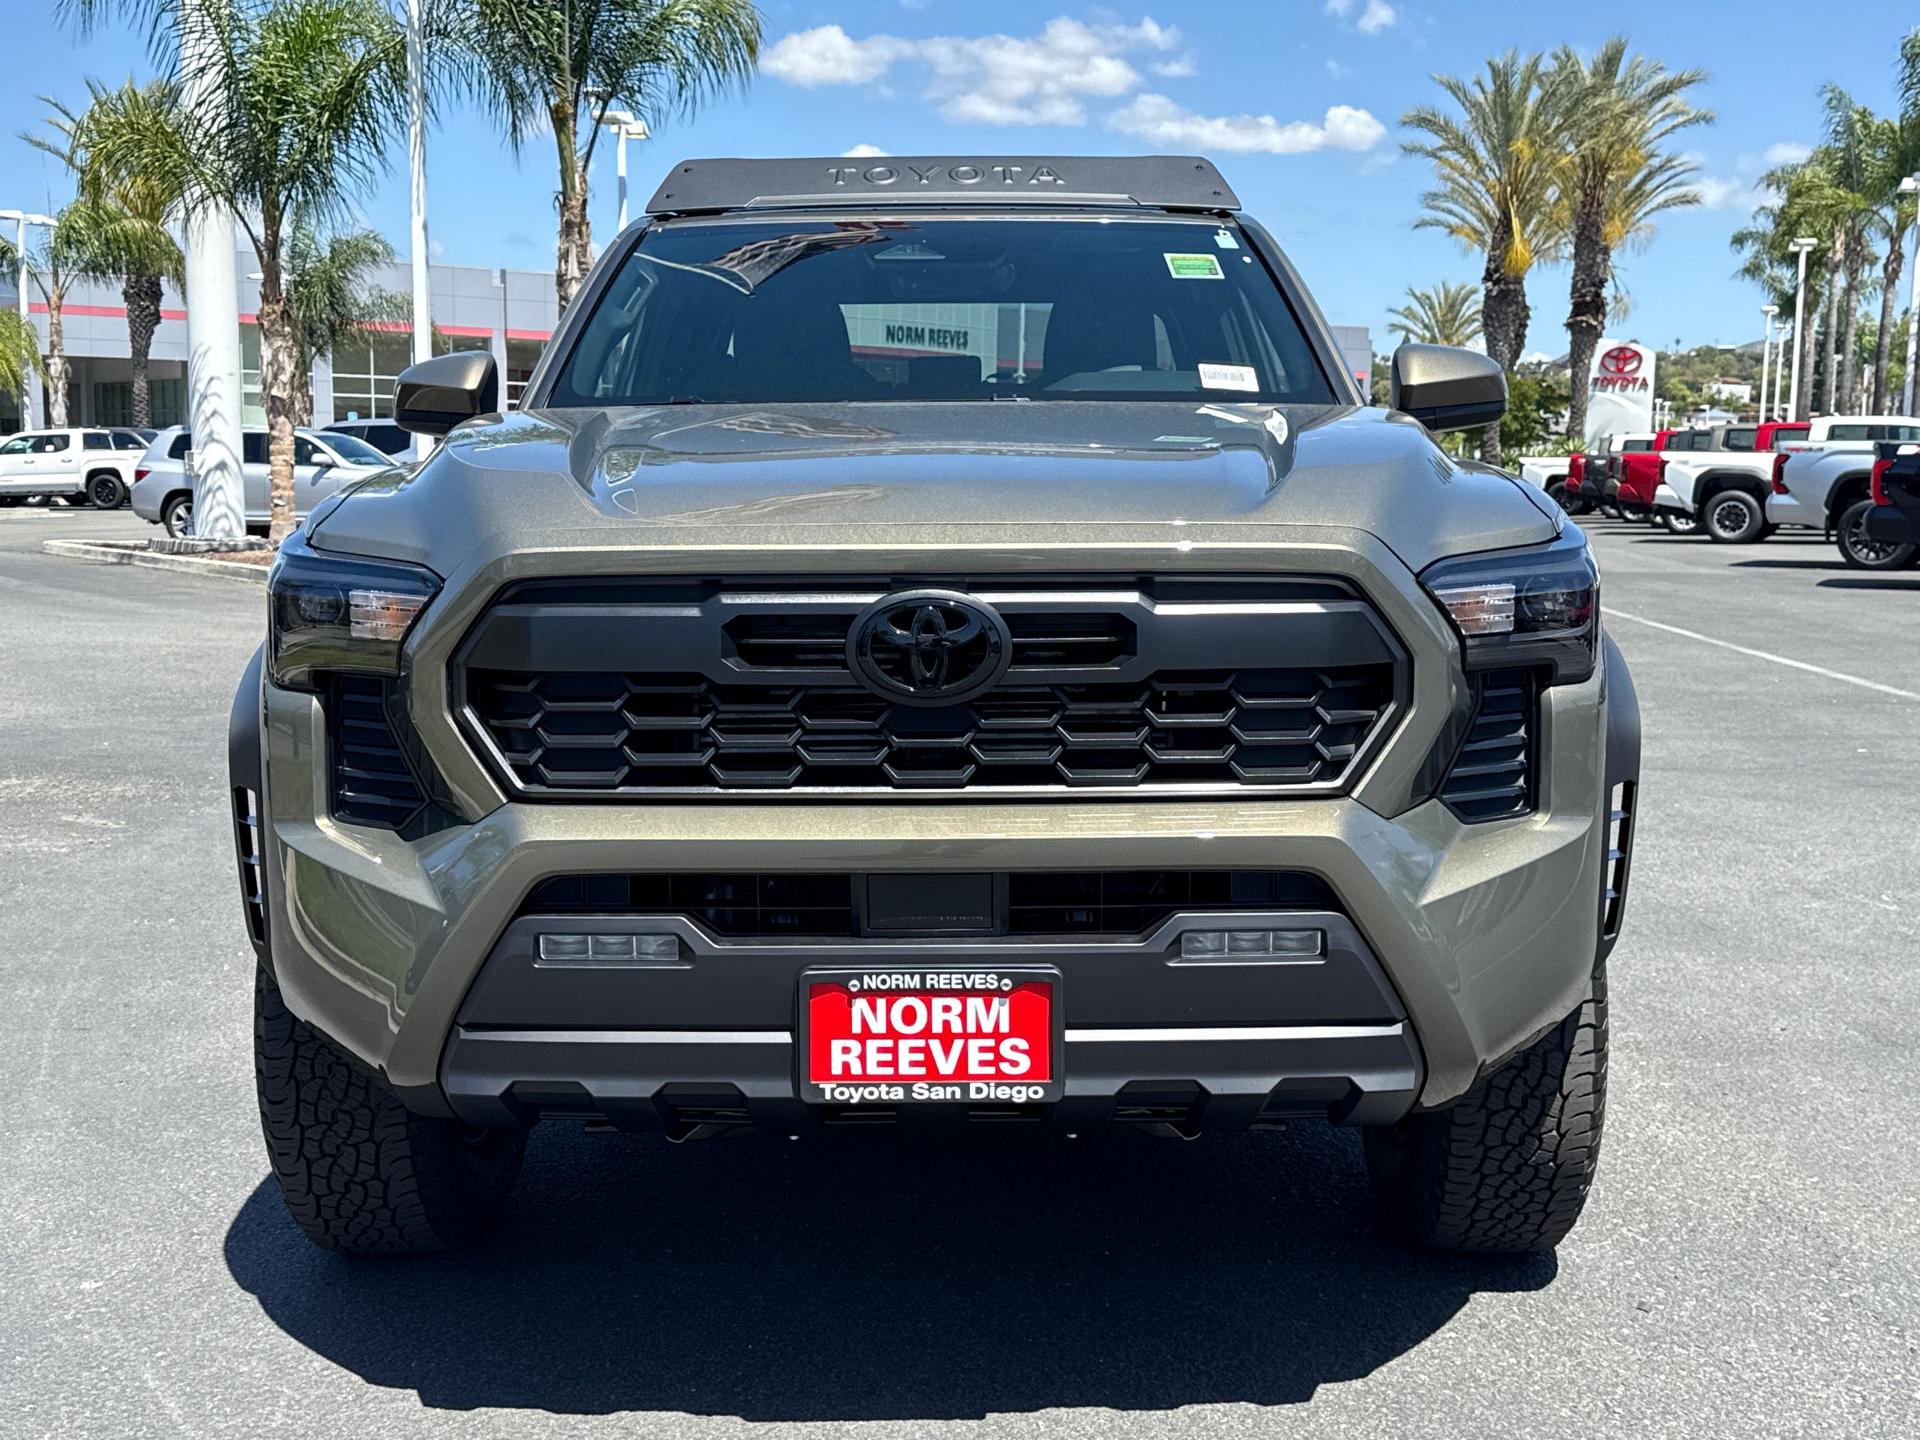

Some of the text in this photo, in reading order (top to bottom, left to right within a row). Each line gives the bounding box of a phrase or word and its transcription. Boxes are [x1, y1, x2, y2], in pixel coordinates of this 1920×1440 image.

[827, 165, 1065, 185] TOYOTA
[886, 325, 968, 350] NORM REEVES
[1591, 375, 1649, 389] TOYOTA
[863, 974, 998, 989] NORM REEVES
[852, 997, 1010, 1034] NORM
[831, 1037, 1031, 1075] REEVES
[819, 1083, 1044, 1103] Toyota San Diego
